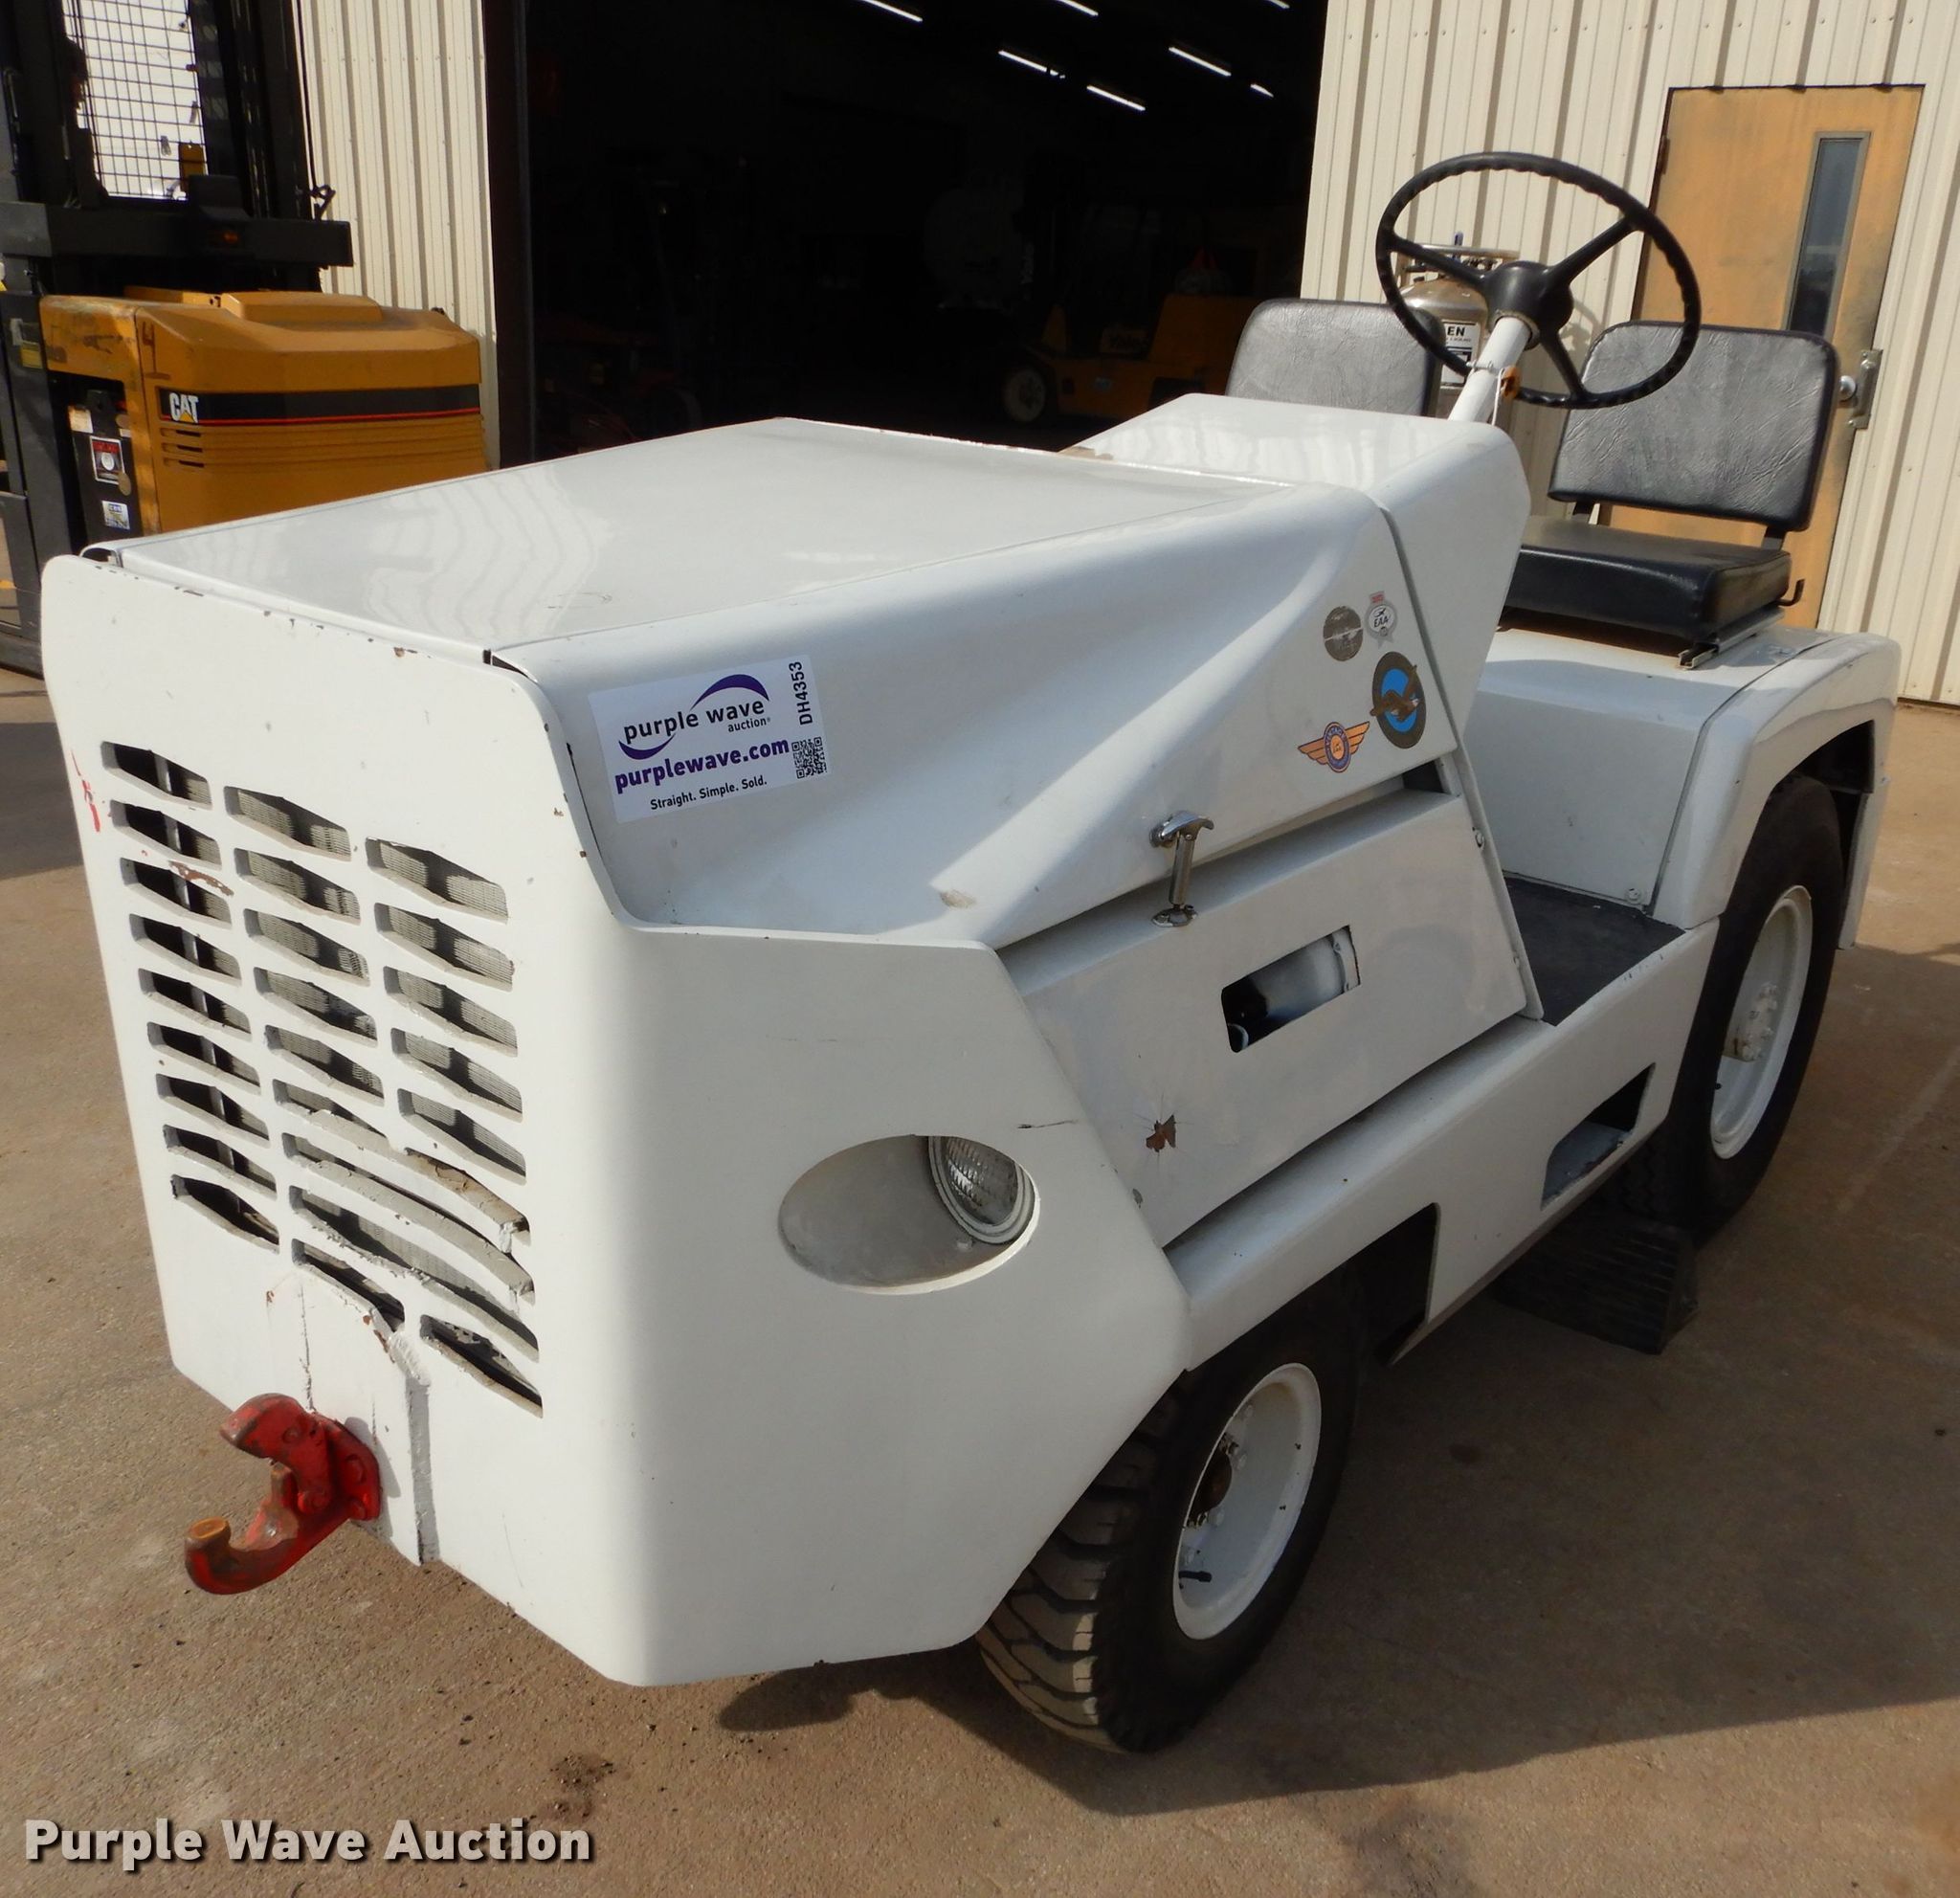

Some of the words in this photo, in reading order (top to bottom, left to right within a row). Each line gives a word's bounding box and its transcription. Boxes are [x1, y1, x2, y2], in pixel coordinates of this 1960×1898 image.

[168, 391, 199, 423] CAT
[789, 660, 813, 726] DH4353
[623, 711, 700, 744] purple
[706, 700, 765, 724] wave
[614, 739, 791, 794] purplewave.com
[650, 792, 697, 810] Straight.
[699, 782, 739, 799] Simple.
[741, 774, 768, 790] Sold.
